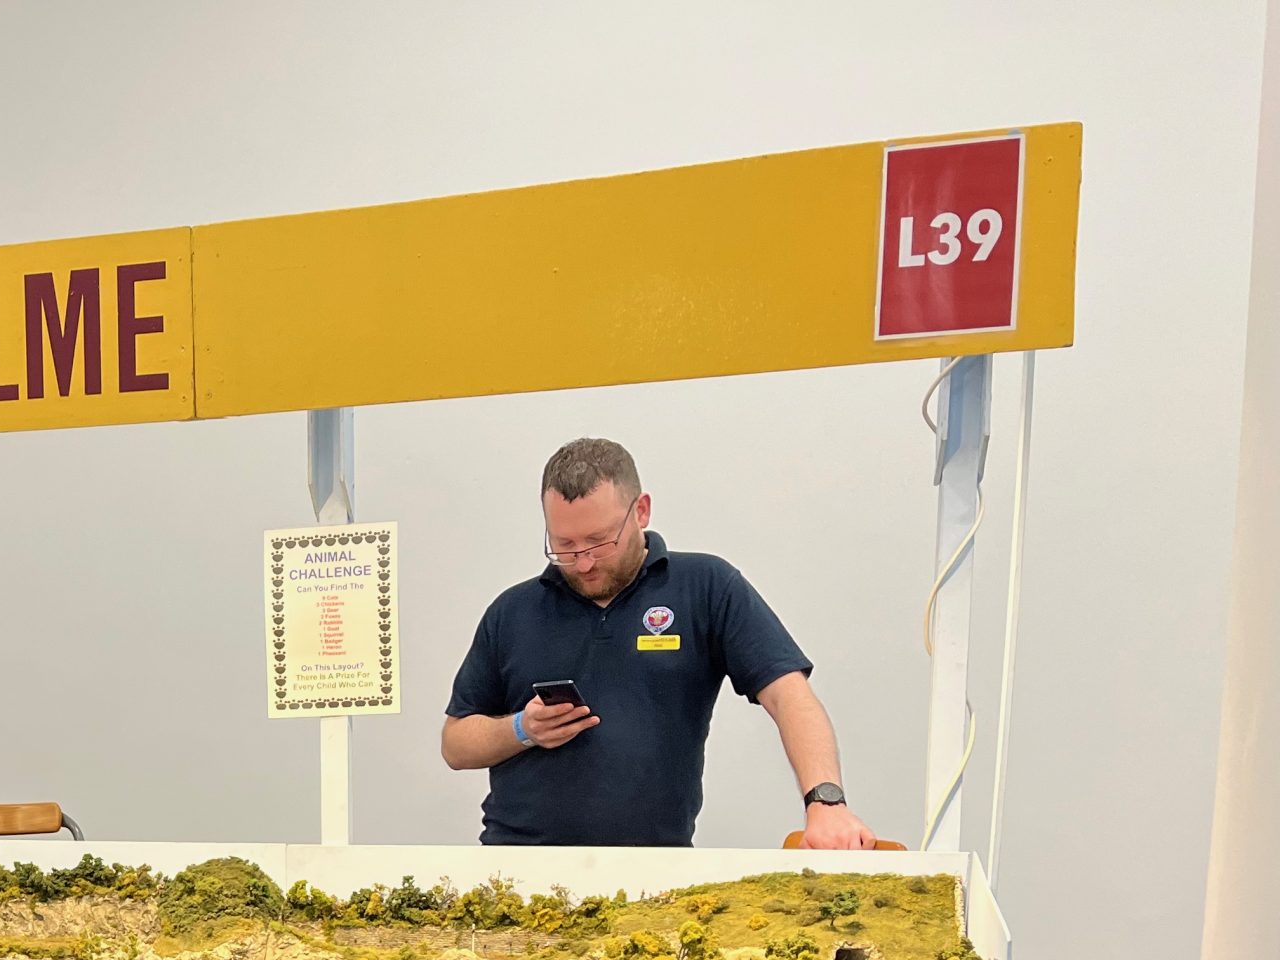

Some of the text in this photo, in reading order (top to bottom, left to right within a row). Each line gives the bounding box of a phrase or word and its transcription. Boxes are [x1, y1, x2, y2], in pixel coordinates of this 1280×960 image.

[898, 208, 1003, 268] L39
[304, 550, 356, 564] ANIMAL
[289, 564, 372, 581] CHALLENGE
[330, 583, 348, 591] Find
[350, 582, 365, 590] The
[301, 664, 313, 672] On
[332, 662, 365, 671] Layout?
[356, 671, 371, 679] For
[293, 683, 315, 691] Every
